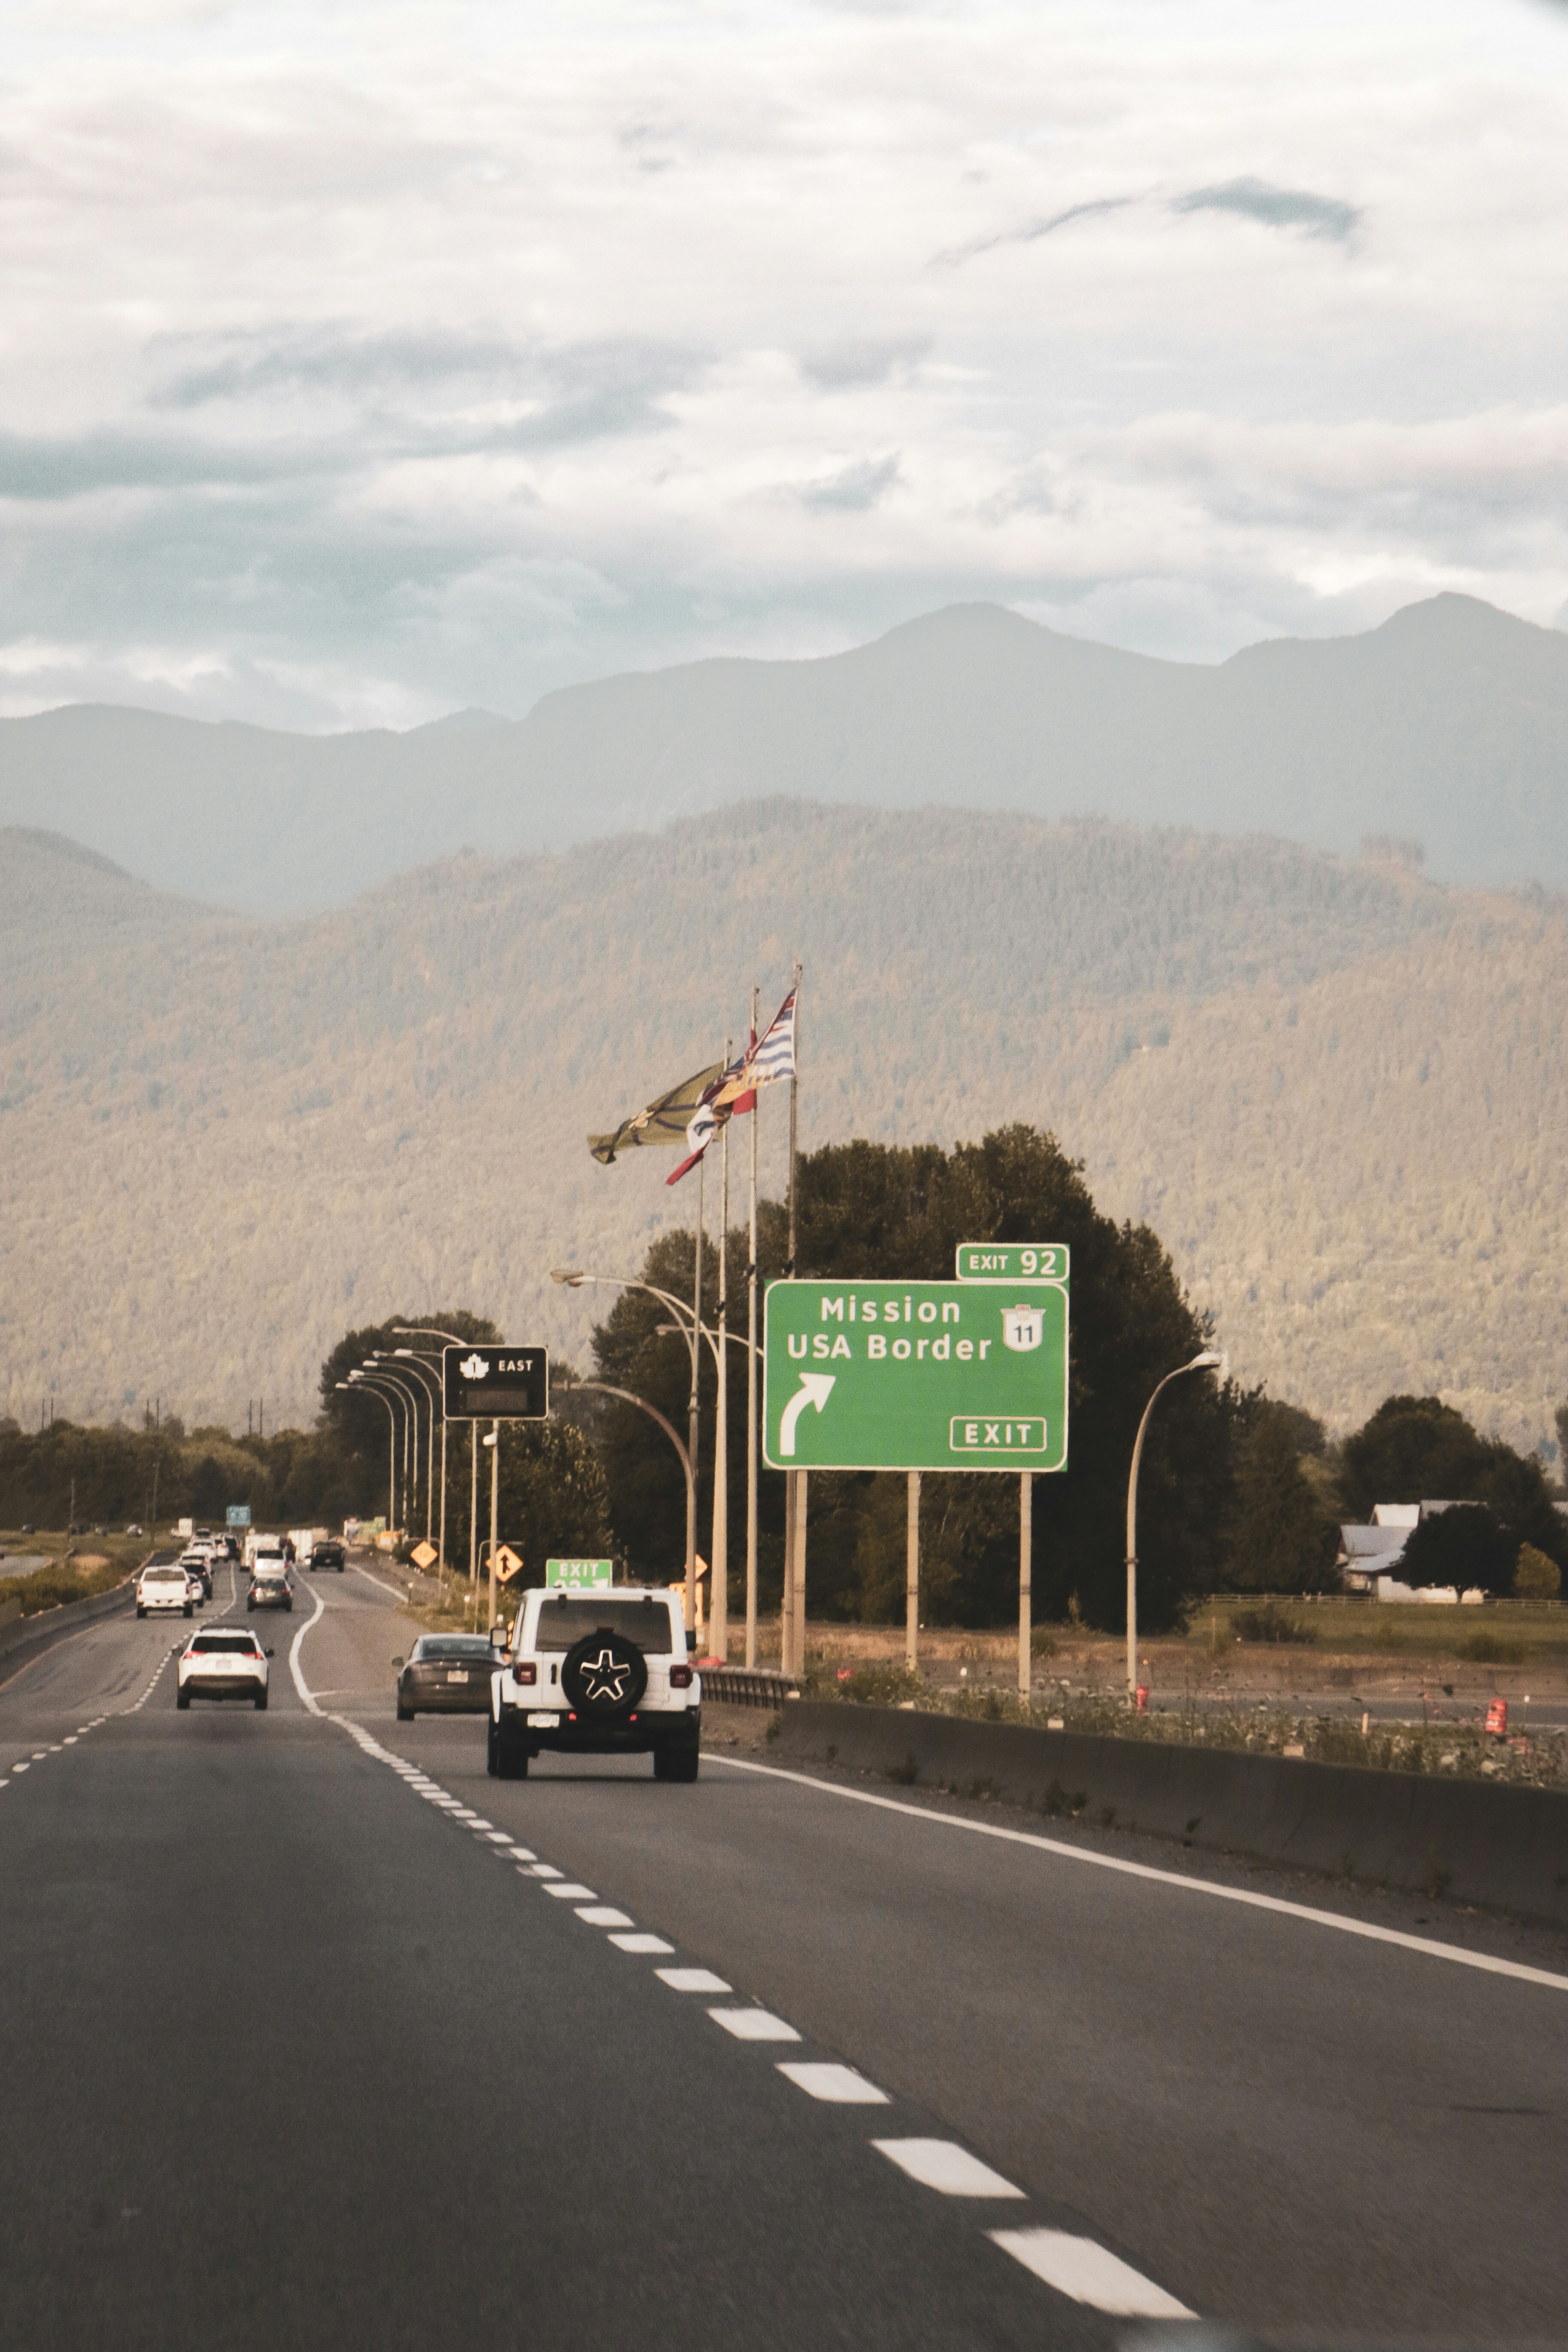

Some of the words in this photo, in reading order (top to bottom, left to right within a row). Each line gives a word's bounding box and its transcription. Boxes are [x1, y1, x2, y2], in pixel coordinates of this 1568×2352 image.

[969, 1255, 1008, 1270] EXIT
[1020, 1250, 1056, 1275] 92
[821, 1295, 960, 1323] Mission
[1014, 1325, 1032, 1343] 11
[787, 1334, 851, 1359] USA
[867, 1334, 992, 1360] Border
[499, 1360, 533, 1372] EAST
[965, 1424, 1031, 1444] EXIT
[559, 1563, 599, 1577] EXIT
